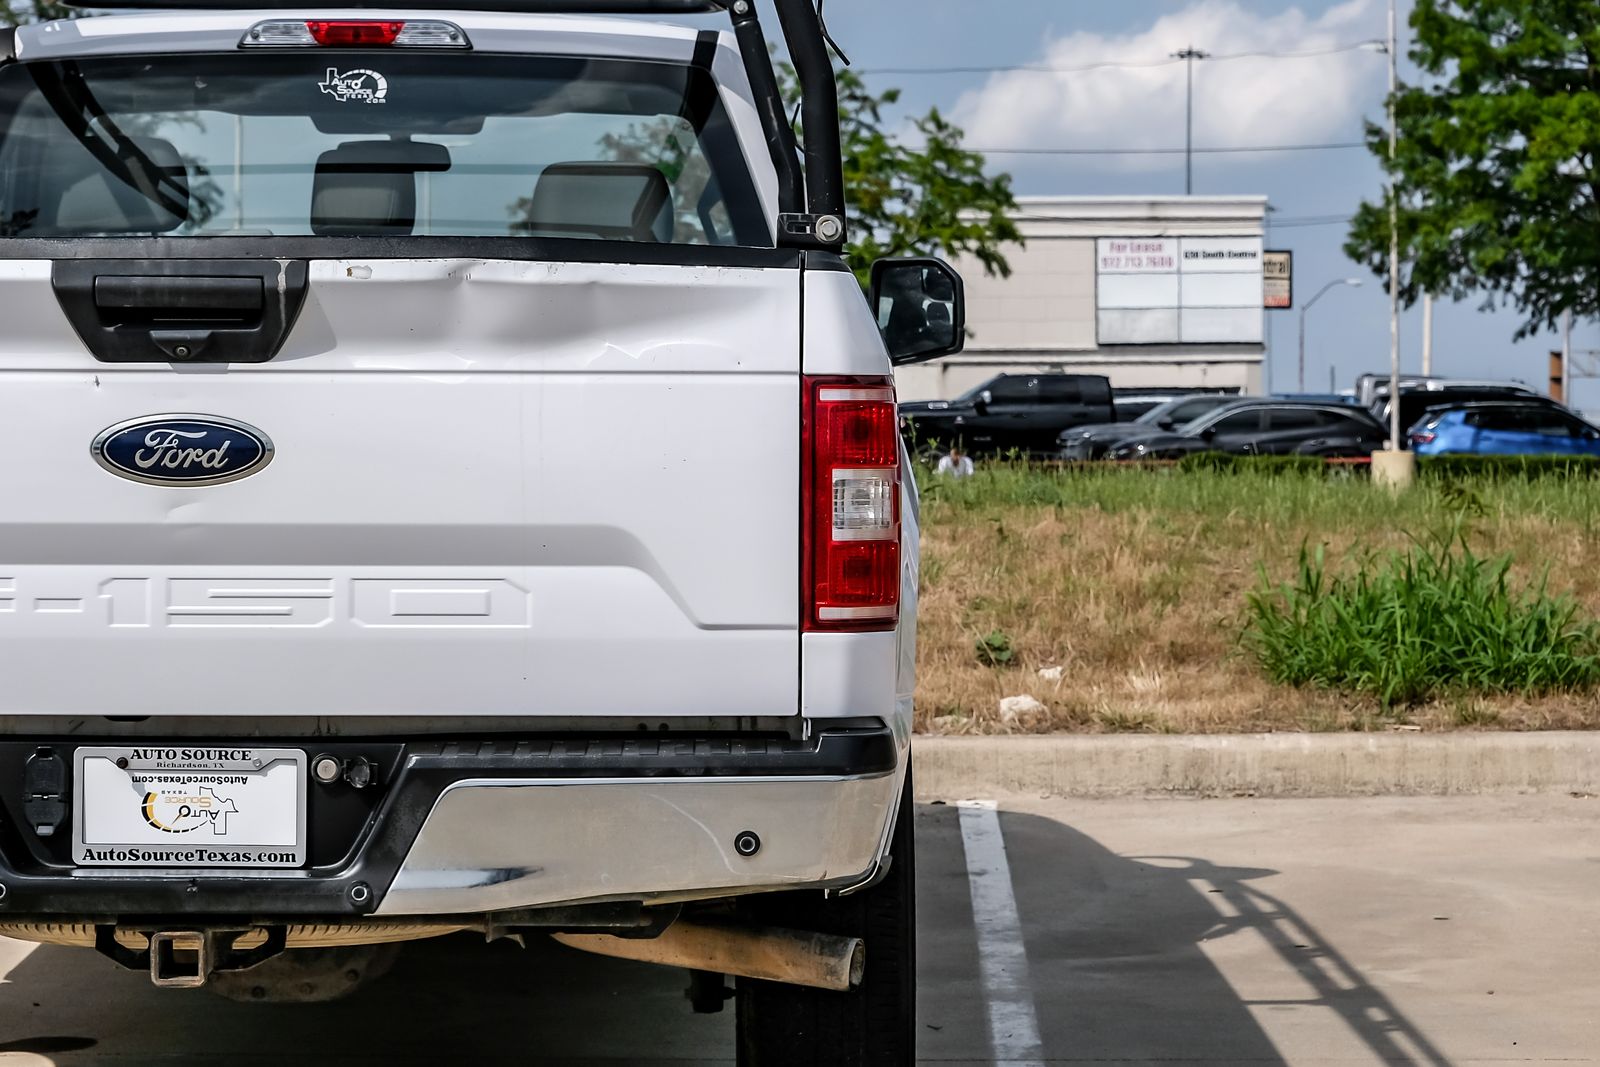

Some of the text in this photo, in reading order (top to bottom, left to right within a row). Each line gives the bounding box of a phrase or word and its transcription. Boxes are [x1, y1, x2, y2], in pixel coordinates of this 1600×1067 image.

[331, 78, 362, 89] AUTO
[134, 429, 231, 469] Ford
[0, 576, 533, 629] -150
[130, 749, 252, 761] AUTO SOURCE
[131, 775, 248, 785] AutoSourceTexas.com
[82, 847, 297, 863] AutoSourceTexas.com
